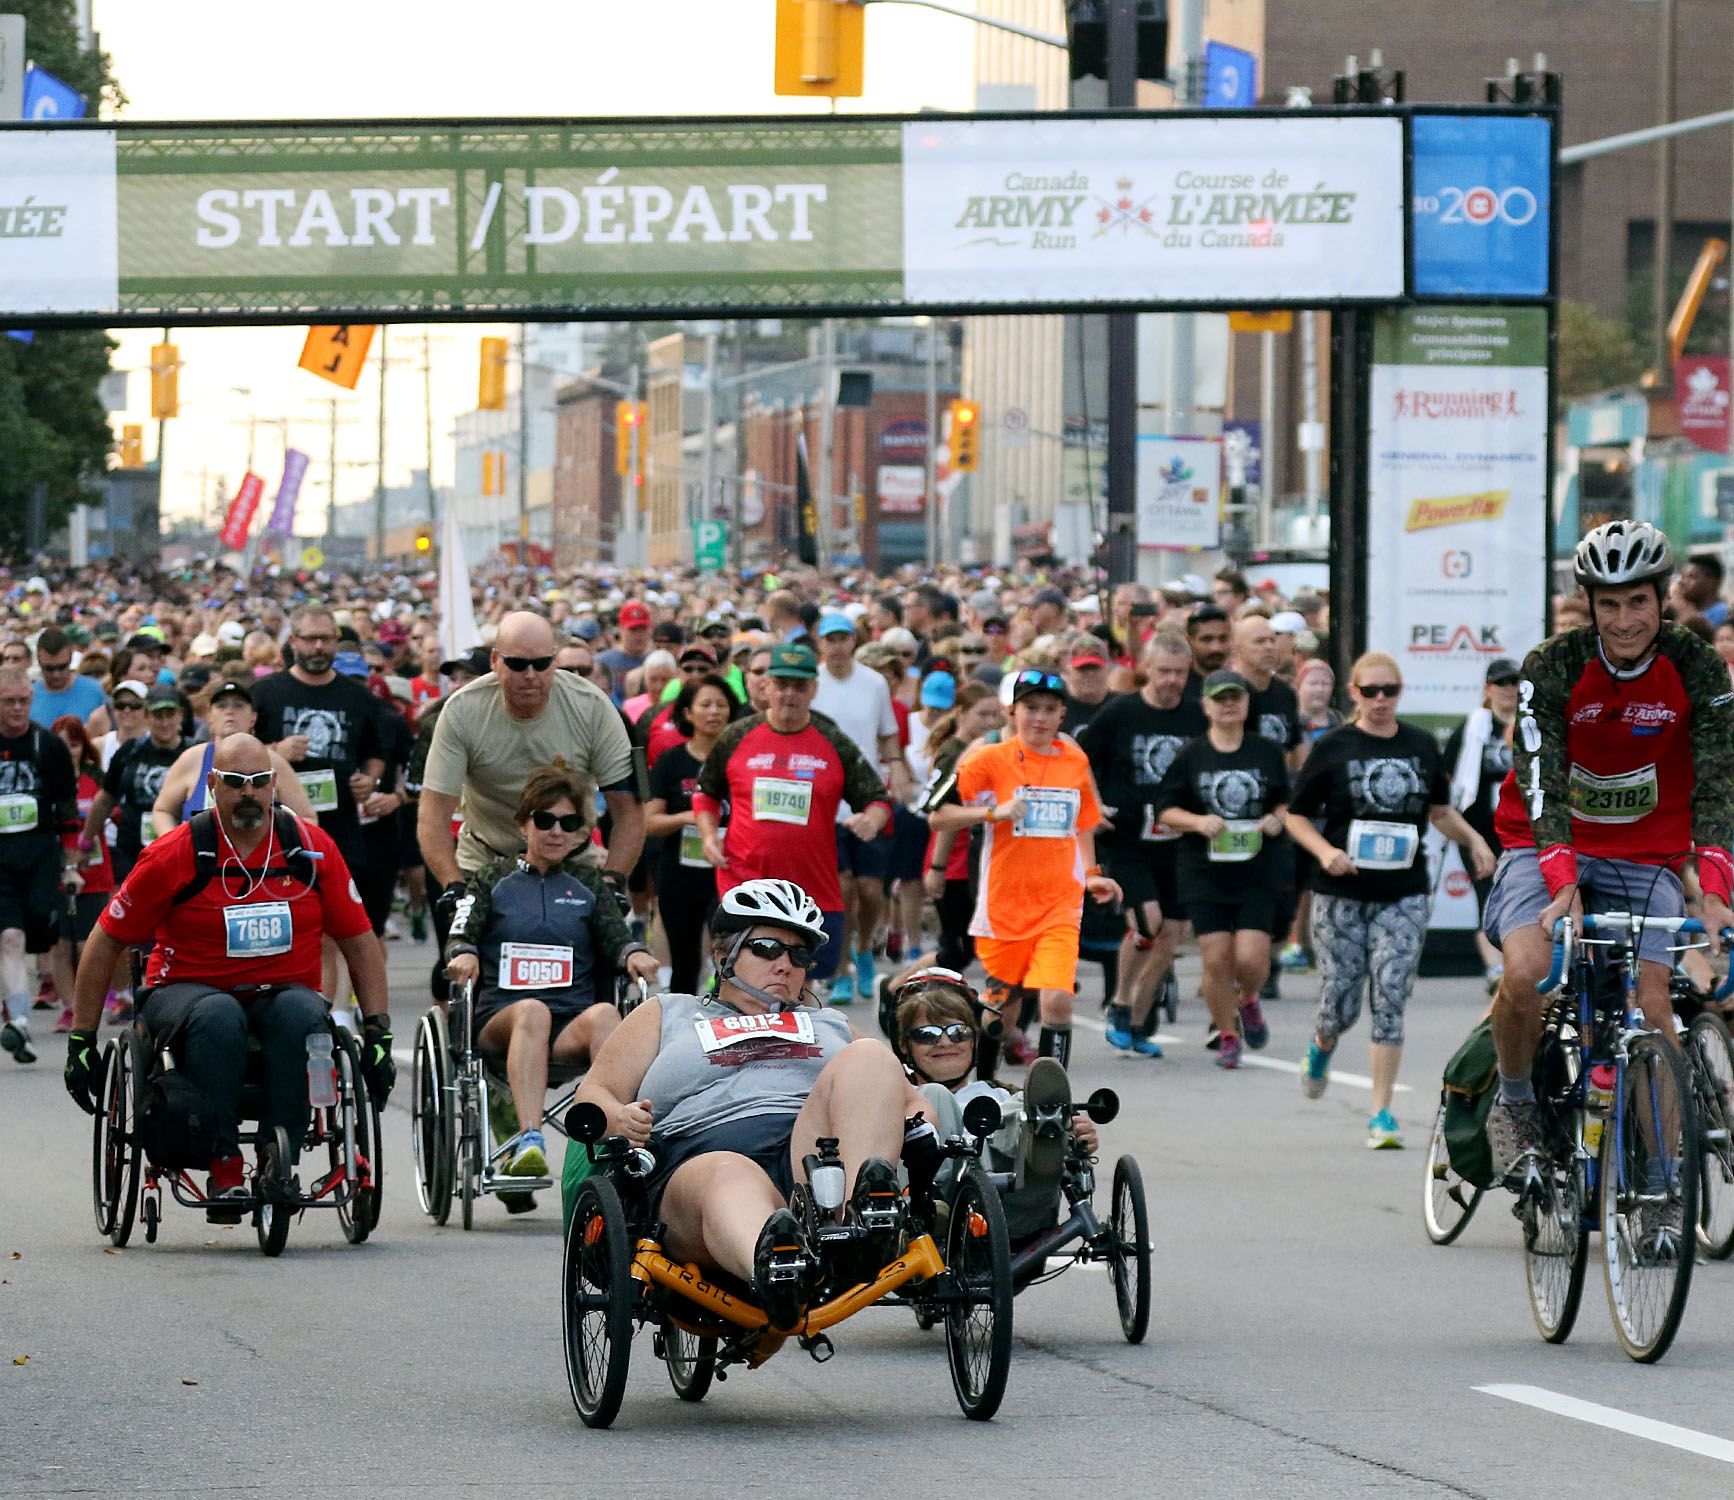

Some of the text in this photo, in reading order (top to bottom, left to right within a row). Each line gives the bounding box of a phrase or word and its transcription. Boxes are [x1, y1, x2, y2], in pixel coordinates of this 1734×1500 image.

[1004, 171, 1089, 191] Canada
[1174, 168, 1289, 190] Course de
[196, 166, 827, 251] START / DÉPART
[955, 195, 1087, 228] ARMY
[1168, 182, 1357, 225] L'ARMÉE
[0, 194, 68, 238] ÉE
[1032, 230, 1077, 249] Run
[1163, 229, 1285, 248] du Canada
[1412, 389, 1503, 418] Running
[698, 522, 720, 552] P
[1408, 624, 1503, 653] PEAK
[307, 783, 321, 799] 57
[767, 791, 806, 810] 19740
[1586, 786, 1651, 809] 23182
[1231, 833, 1249, 847] 56
[236, 917, 282, 942] 7668
[517, 960, 563, 981] 6050
[723, 1013, 784, 1030] 6012
